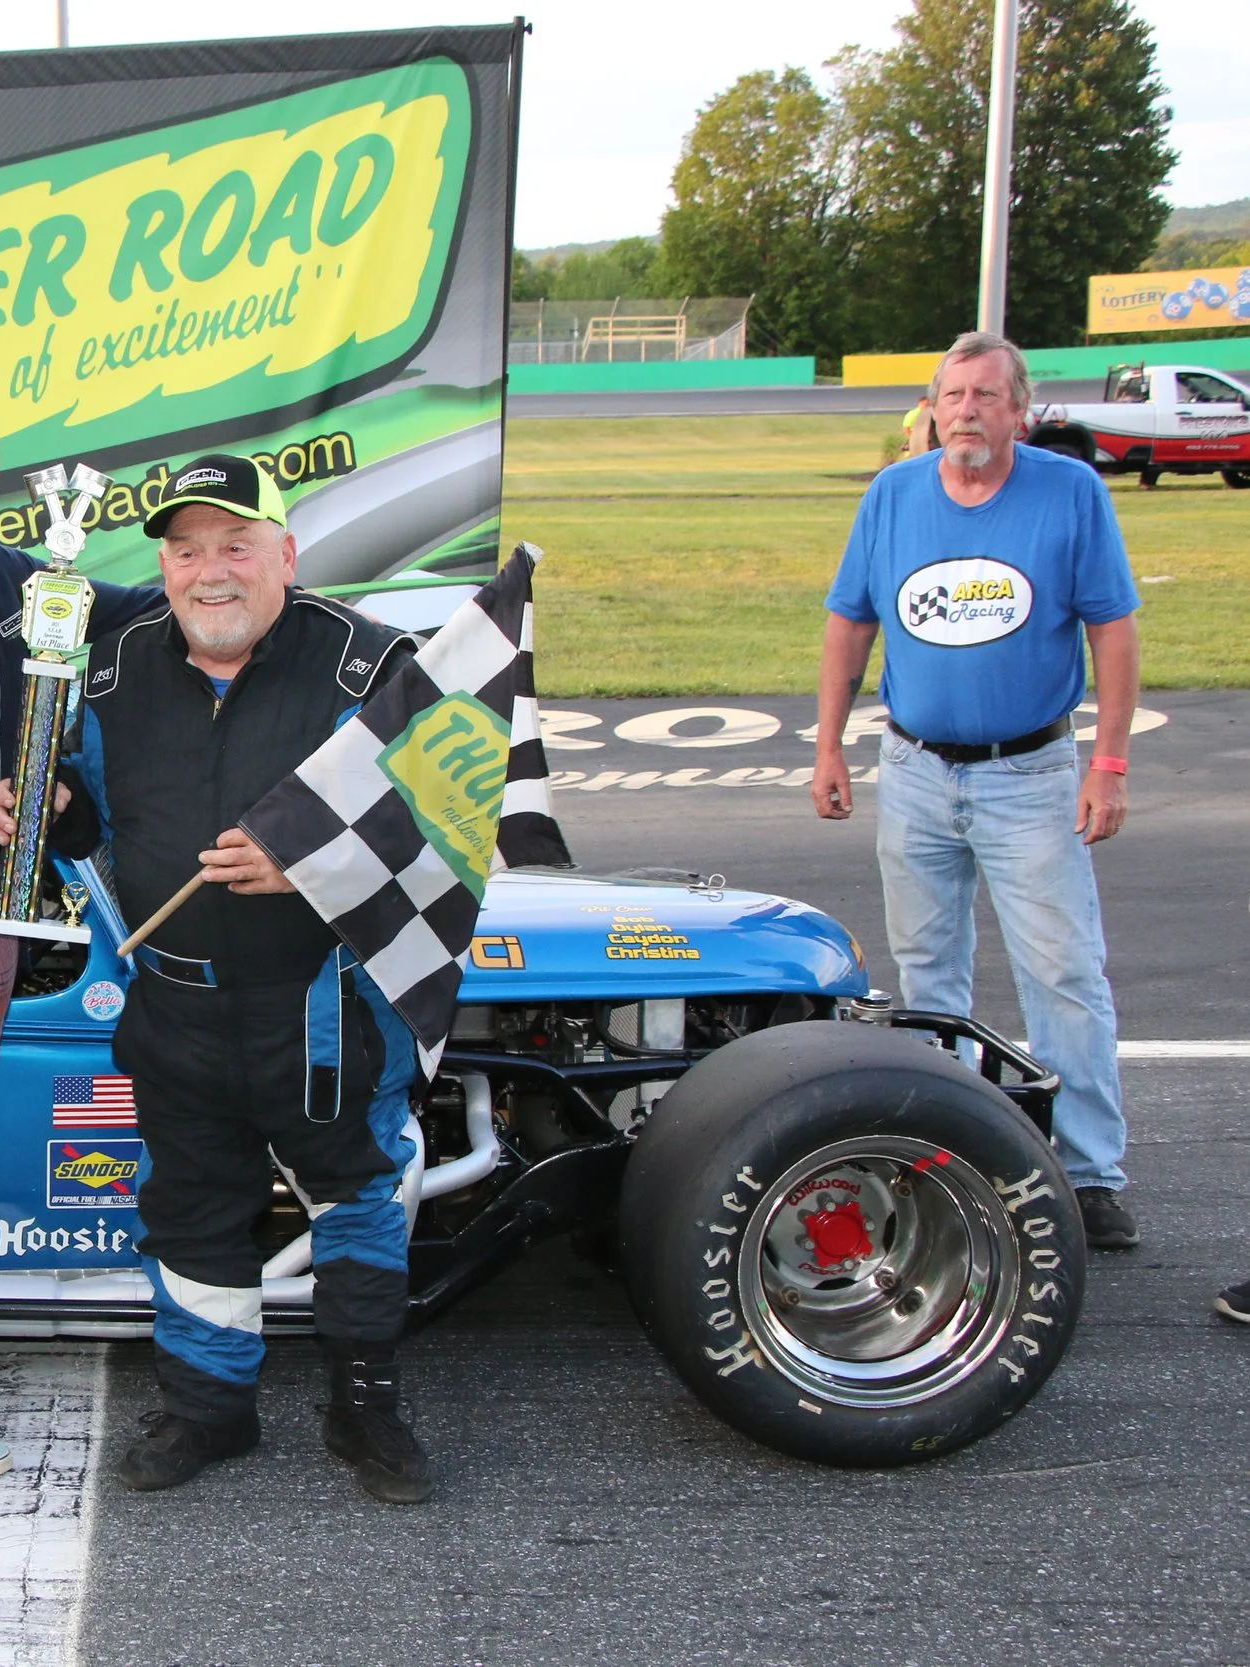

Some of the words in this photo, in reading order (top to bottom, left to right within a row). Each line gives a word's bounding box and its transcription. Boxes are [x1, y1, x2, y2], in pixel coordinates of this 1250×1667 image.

[110, 133, 395, 294] ROAD
[1101, 291, 1167, 308] LOTTERY
[9, 323, 56, 403] of
[951, 577, 1015, 602] ARCA
[949, 603, 1016, 625] Racing
[36, 637, 47, 646] 1st
[48, 638, 70, 650] Place
[611, 923, 673, 934] Dylan
[607, 933, 689, 947] Caydon
[605, 946, 701, 960] Christina
[58, 1163, 136, 1178] SUNOCO
[52, 1195, 80, 1204] OFFICIAL
[81, 1195, 98, 1203] FUEL
[699, 1165, 764, 1379] Hoosier
[994, 1168, 1061, 1383] Hoosier
